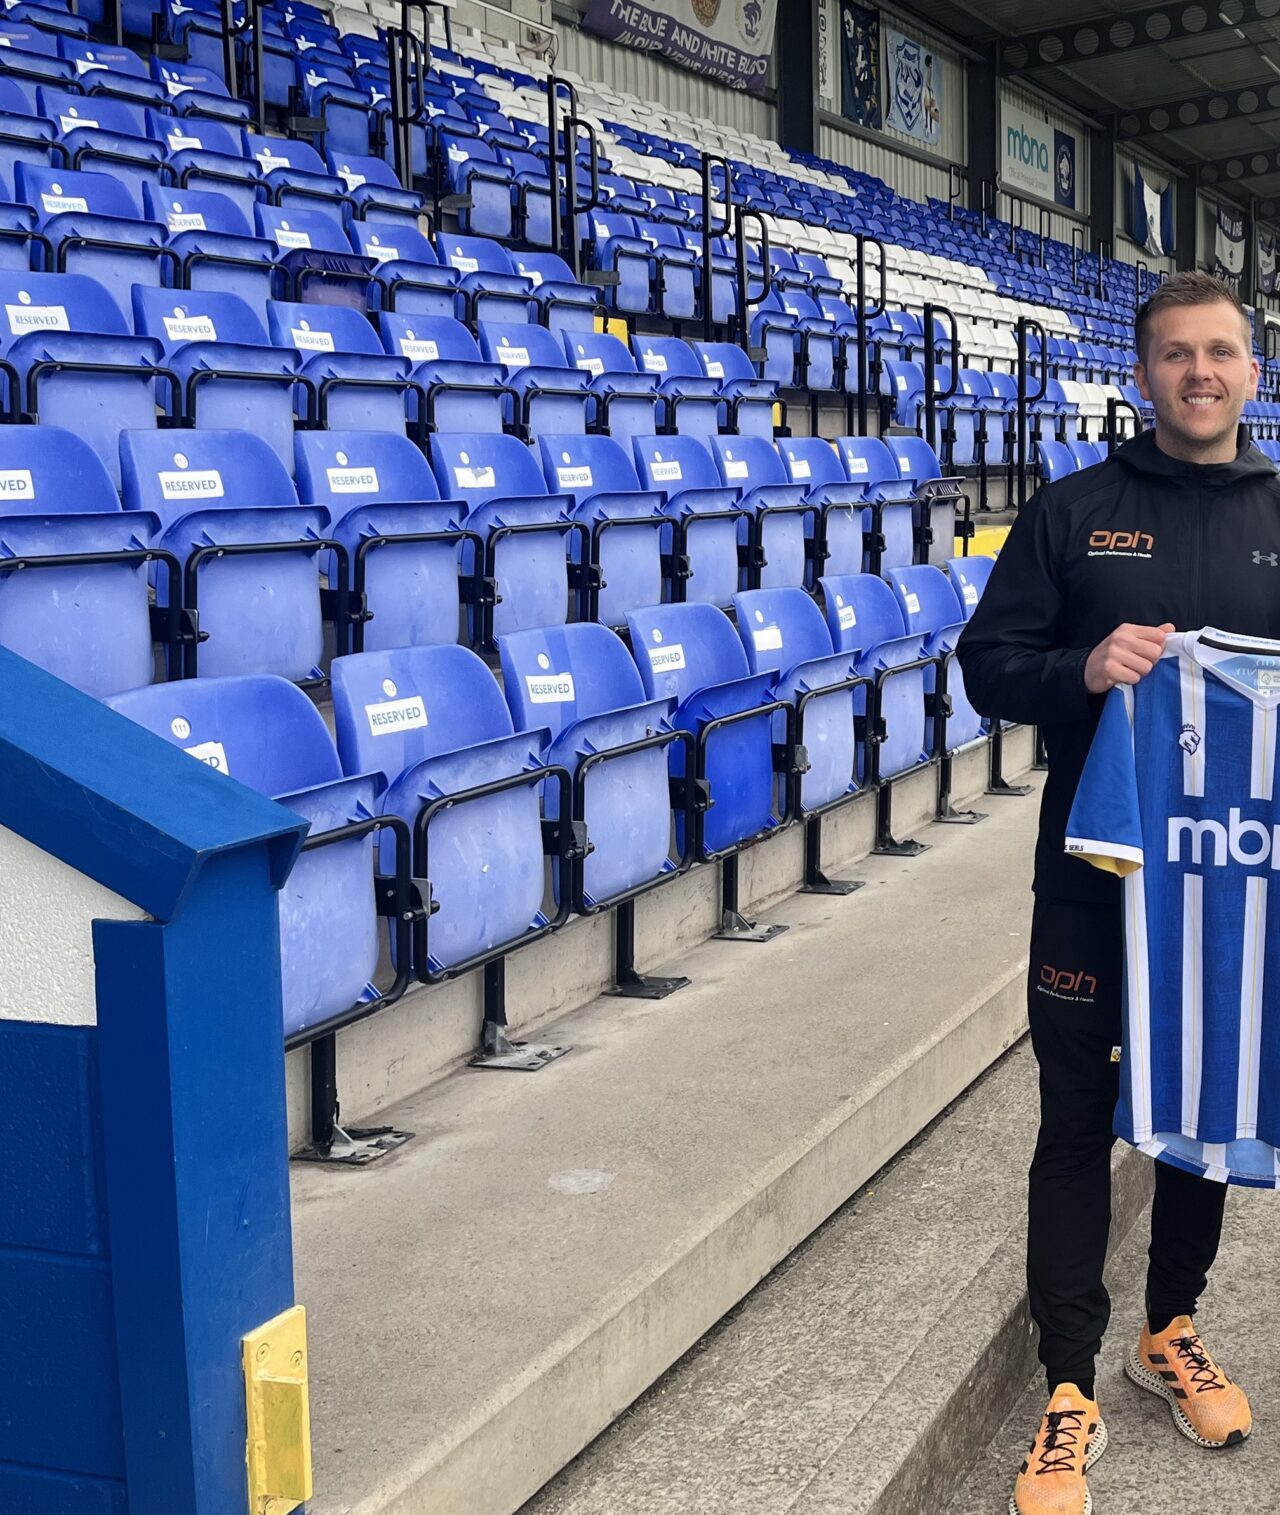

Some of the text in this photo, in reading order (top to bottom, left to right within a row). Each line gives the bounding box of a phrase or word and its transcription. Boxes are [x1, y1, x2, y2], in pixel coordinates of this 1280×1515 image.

[671, 25, 700, 54] AND
[1007, 123, 1048, 173] mbna
[15, 314, 59, 325] RESERVED
[169, 323, 211, 334] RESERVED
[296, 334, 330, 346] RESERVED
[165, 479, 217, 491] RESERVED
[331, 475, 373, 485] RESERVED
[1089, 530, 1154, 550] oph
[651, 652, 681, 666] ESERVED
[530, 683, 570, 695] RESERVED
[371, 706, 421, 726] RESERVED
[174, 724, 188, 733] 111
[1040, 965, 1097, 993] oph
